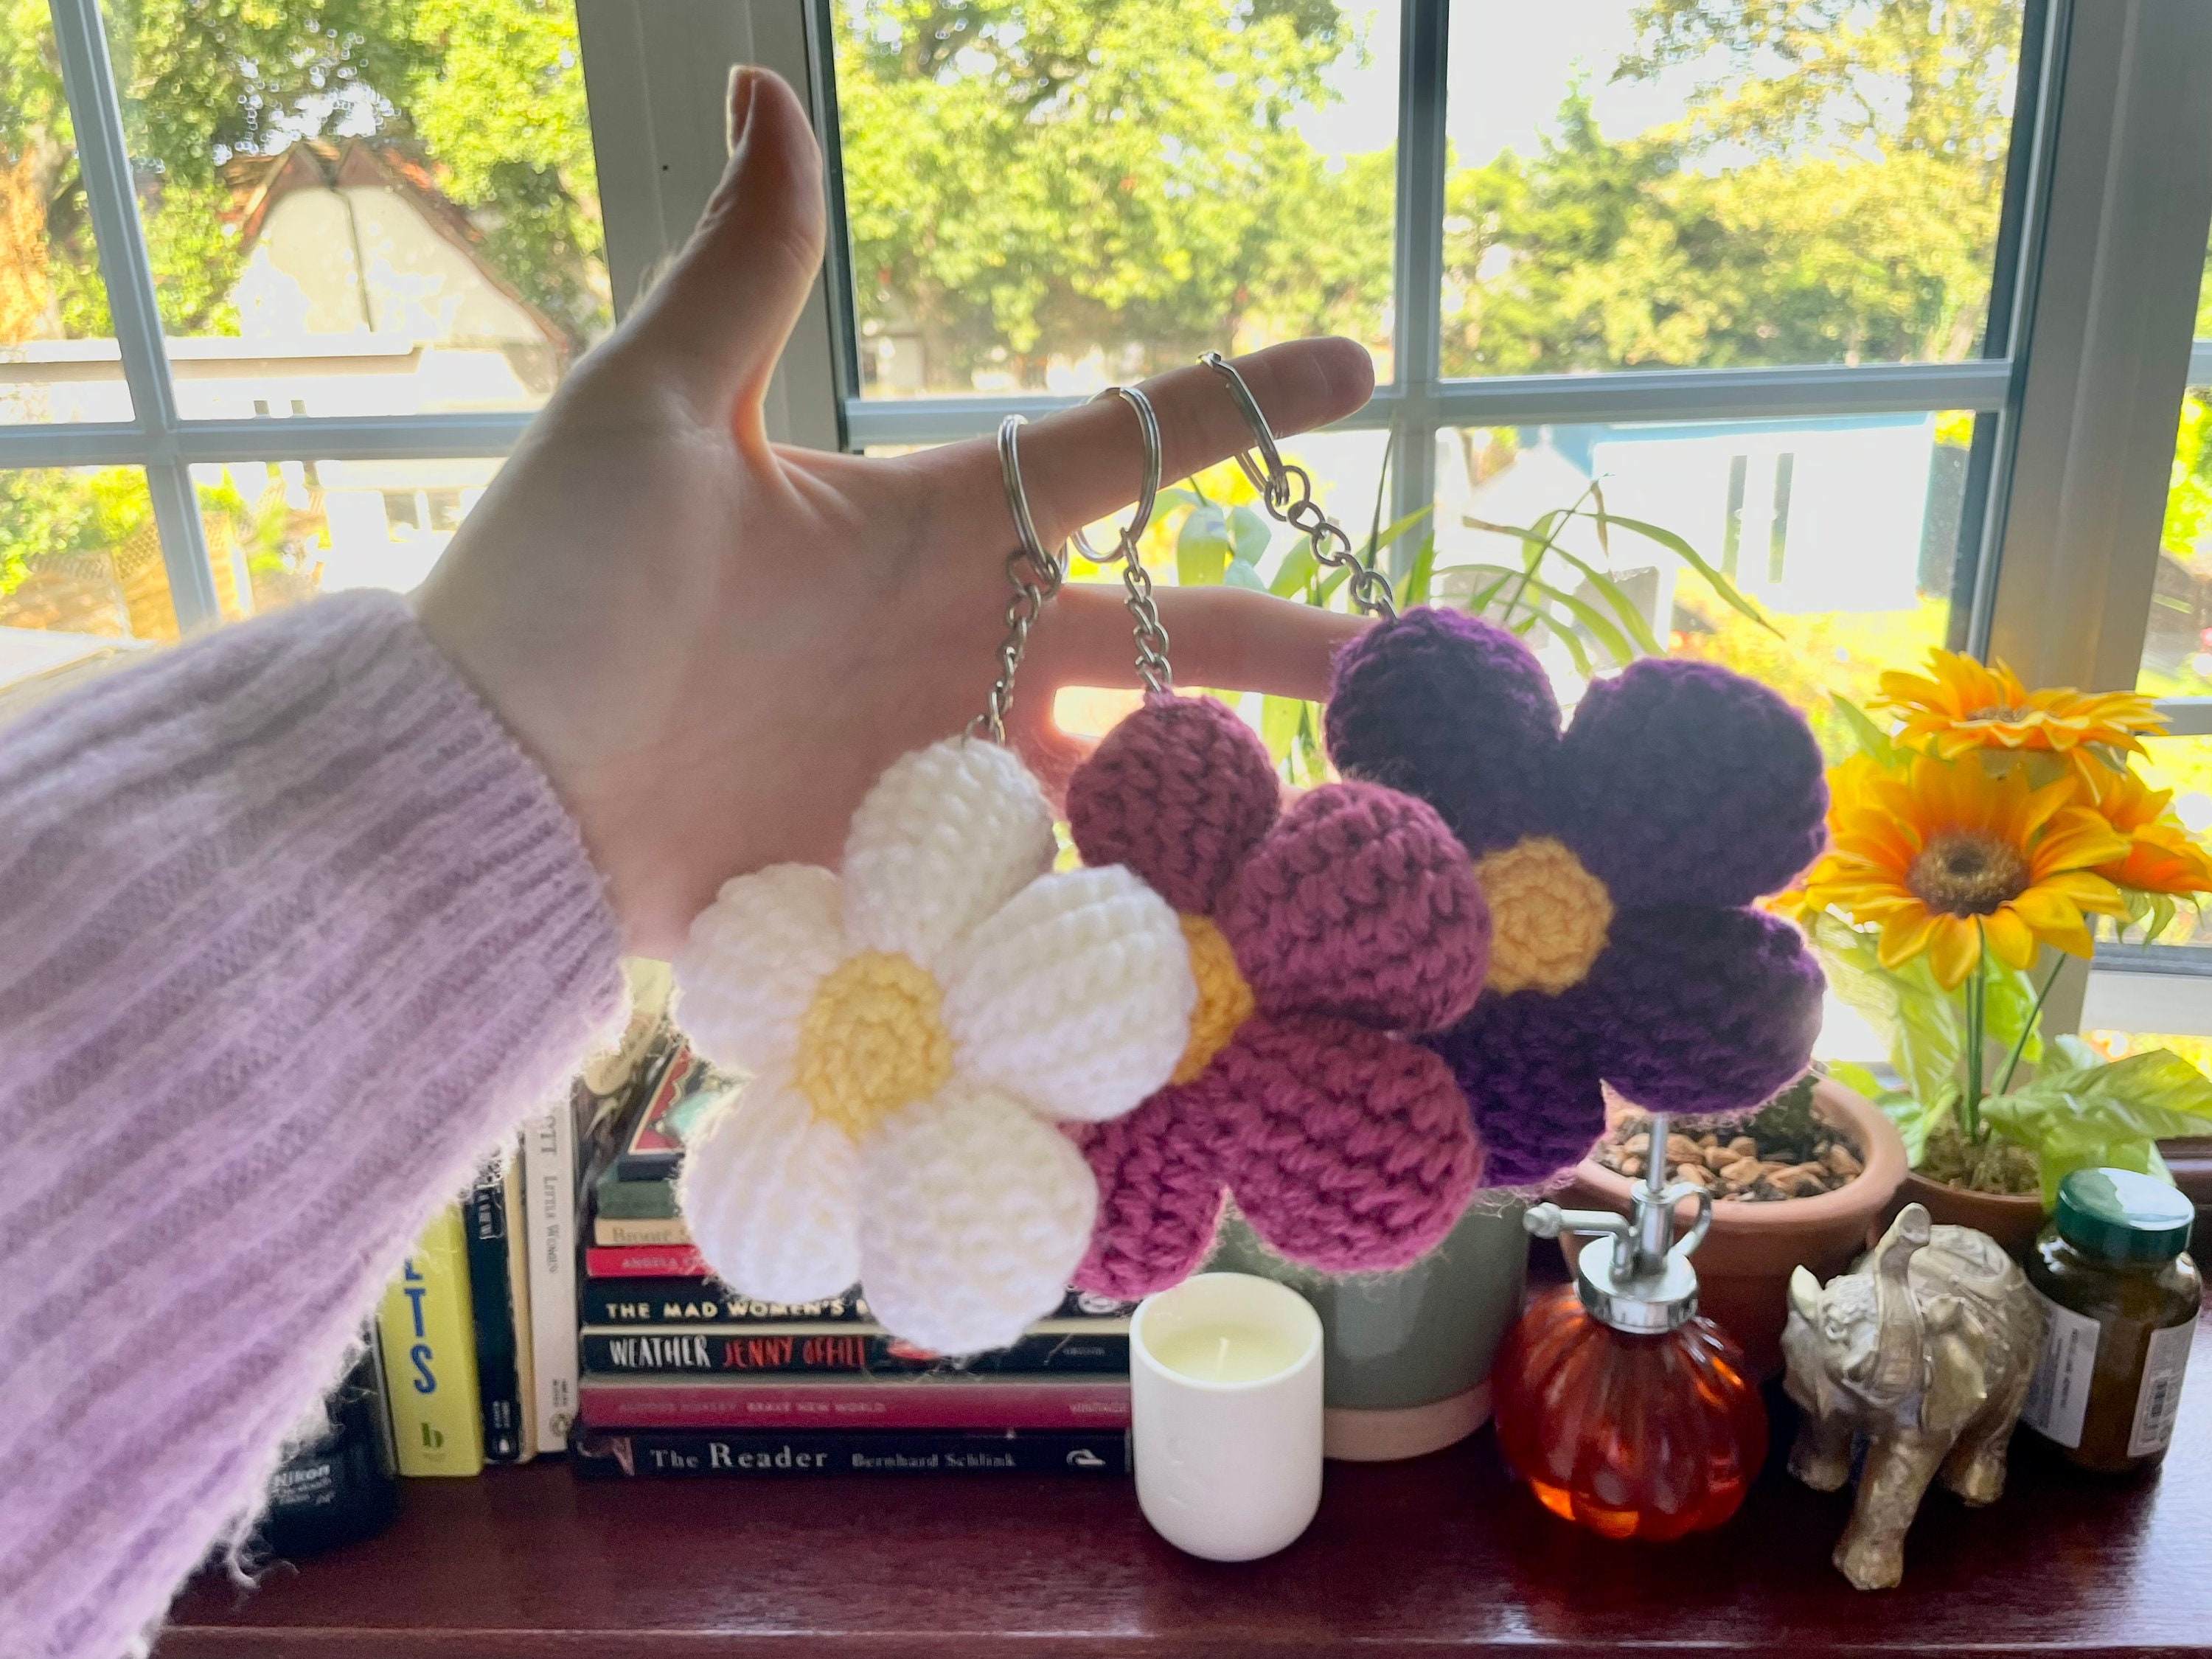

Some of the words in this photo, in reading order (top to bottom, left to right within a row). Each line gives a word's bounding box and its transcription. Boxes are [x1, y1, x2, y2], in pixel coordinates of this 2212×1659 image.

[605, 1301, 651, 1319] THE
[663, 1301, 718, 1318] MAD
[609, 1334, 712, 1368] WEATHER
[722, 1335, 794, 1368] JENNY
[649, 1448, 700, 1468] The
[709, 1441, 829, 1468] Reader
